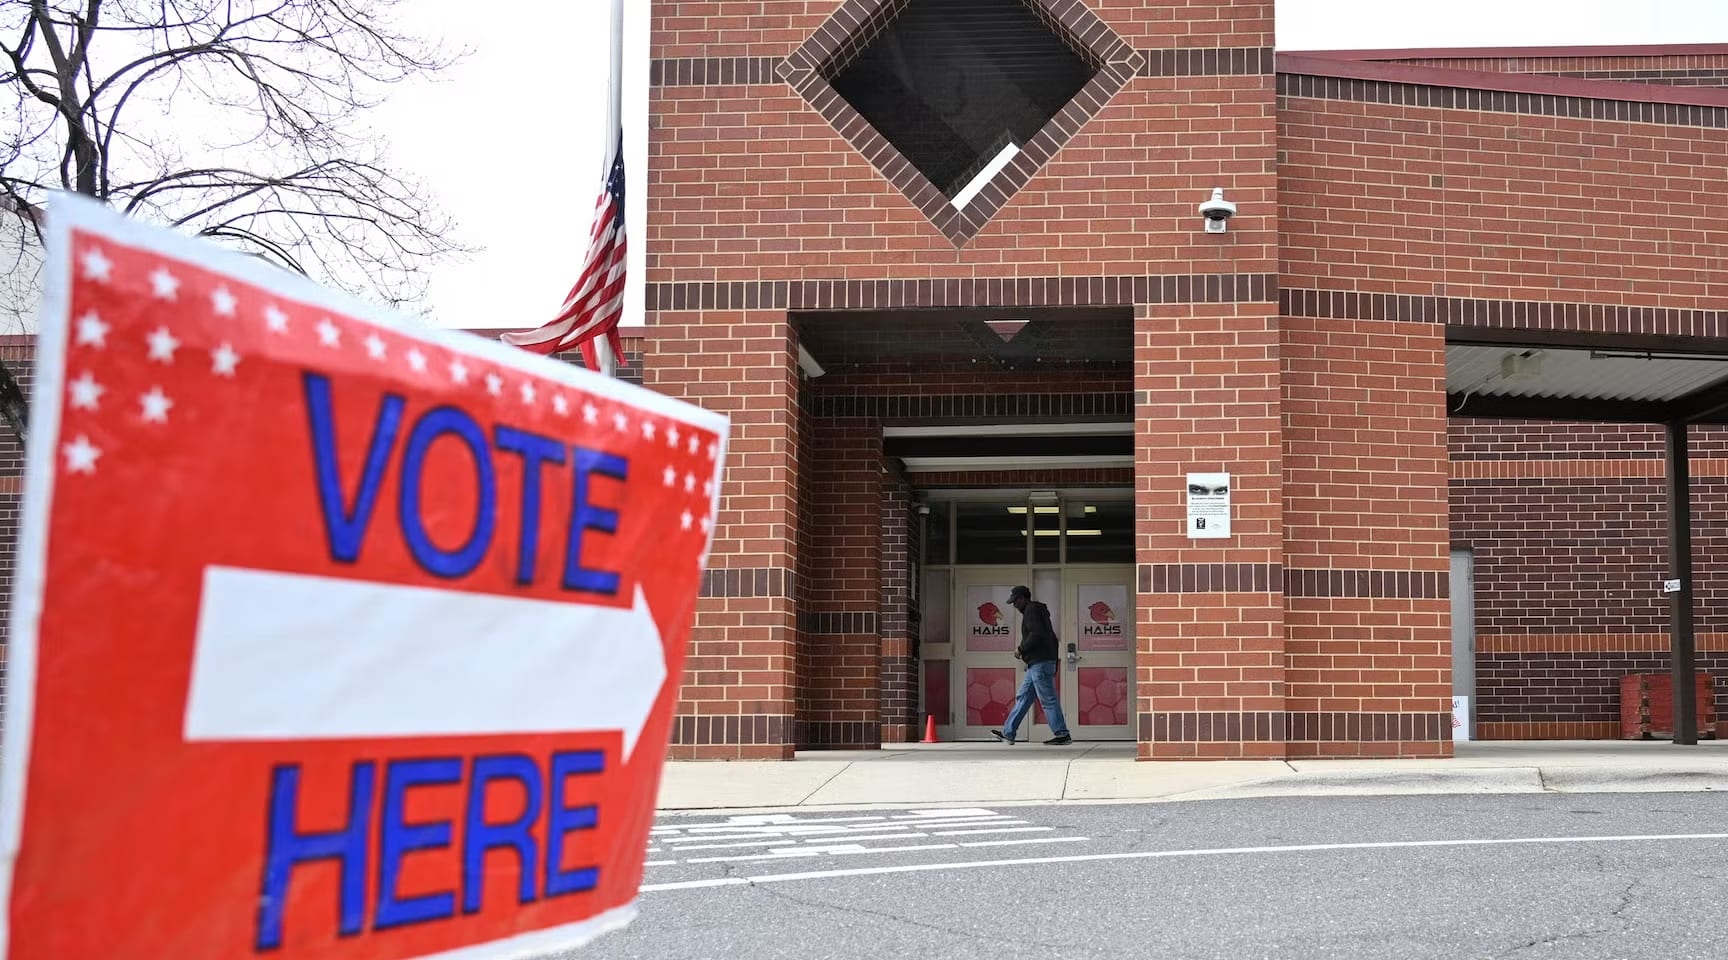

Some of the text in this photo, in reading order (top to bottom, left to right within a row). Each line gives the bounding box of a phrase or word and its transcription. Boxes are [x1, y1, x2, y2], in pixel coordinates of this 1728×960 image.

[303, 372, 628, 596] VOTE
[973, 626, 1010, 635] HAHS
[1084, 625, 1121, 635] HAHS
[255, 749, 606, 952] HERE
